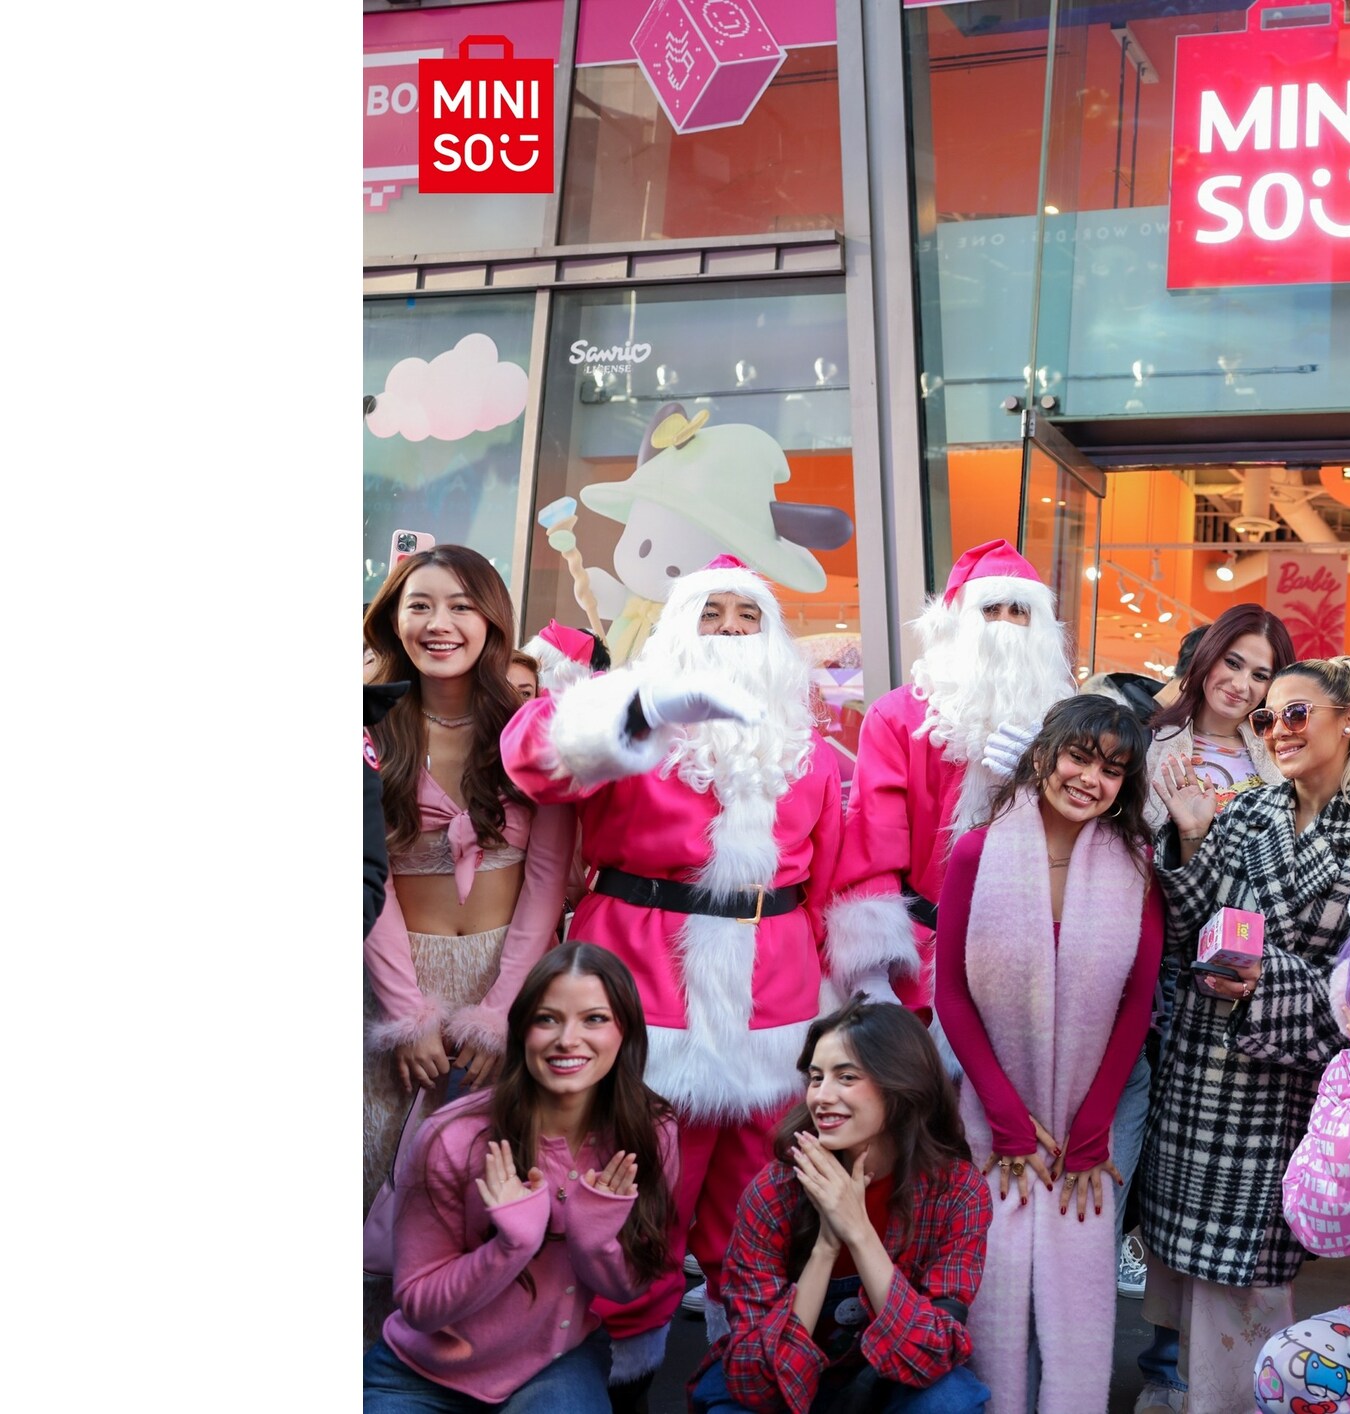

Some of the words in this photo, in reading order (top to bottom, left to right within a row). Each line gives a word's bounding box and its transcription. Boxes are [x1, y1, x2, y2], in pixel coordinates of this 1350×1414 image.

[366, 82, 419, 116] BO
[569, 339, 652, 364] Sanrio
[585, 363, 632, 375] LICENSE
[1276, 562, 1342, 600] Barbie
[1239, 922, 1249, 941] TOY
